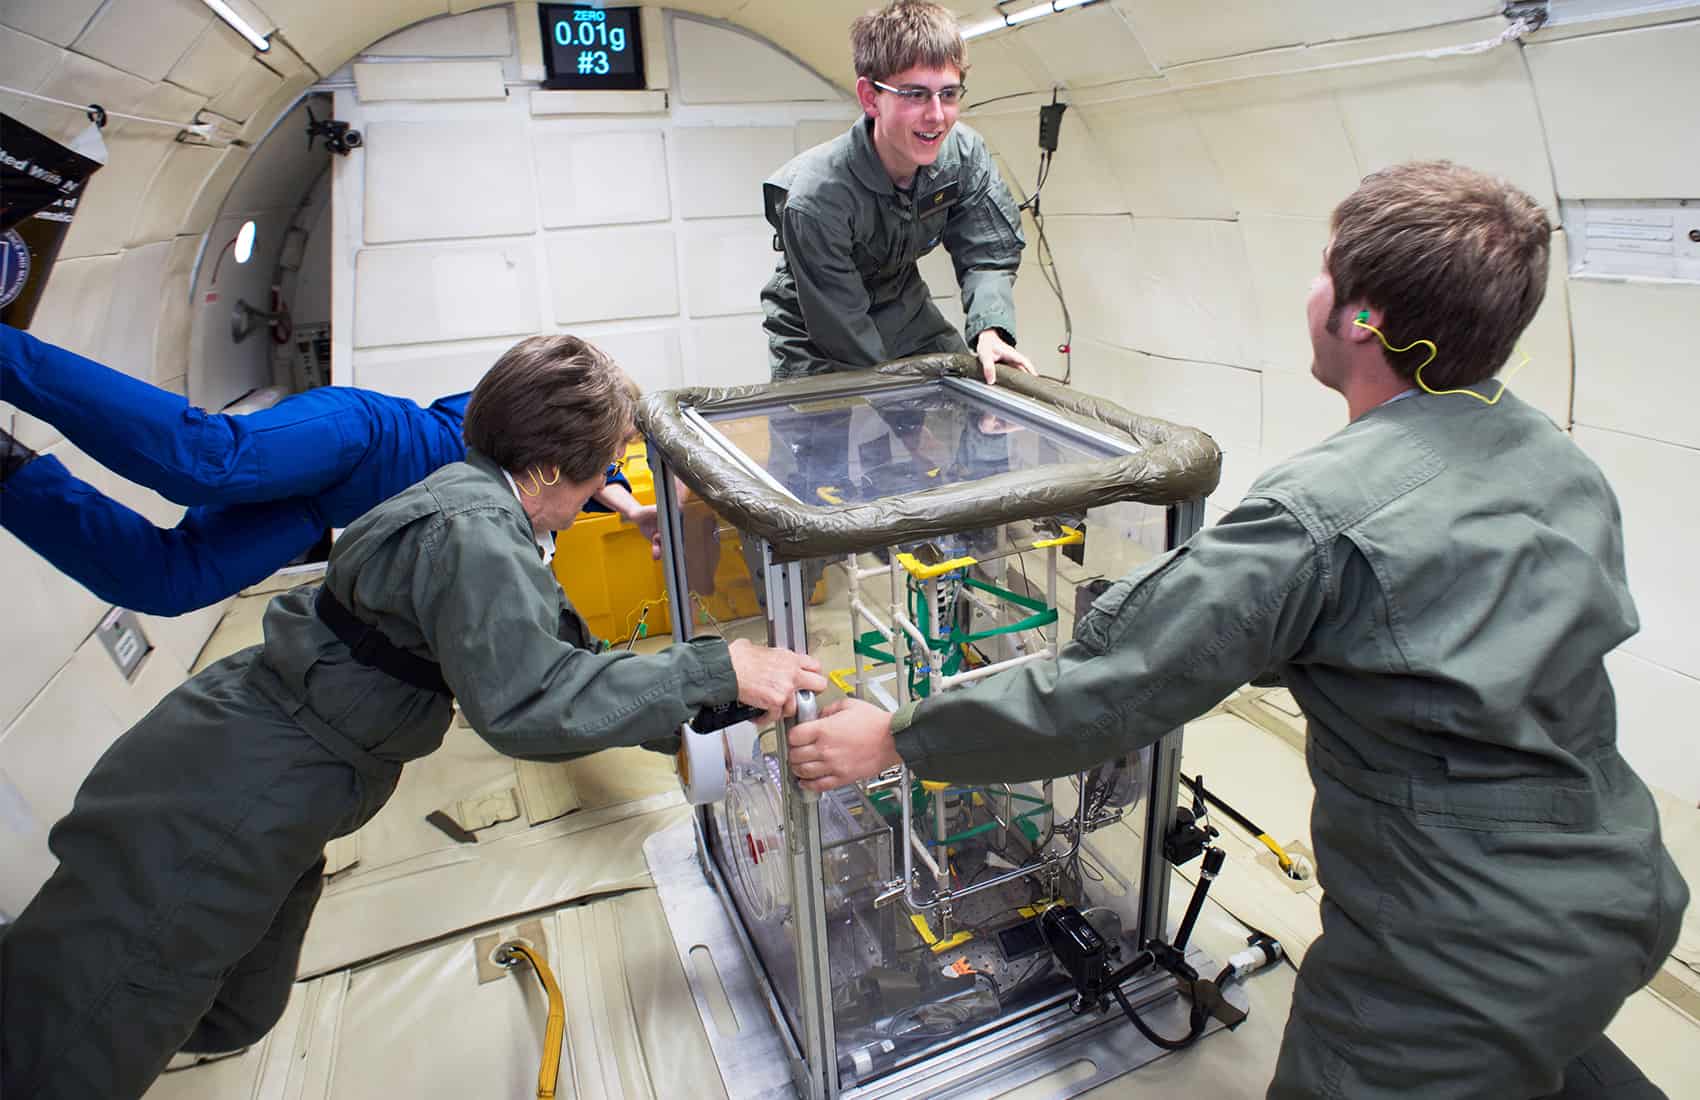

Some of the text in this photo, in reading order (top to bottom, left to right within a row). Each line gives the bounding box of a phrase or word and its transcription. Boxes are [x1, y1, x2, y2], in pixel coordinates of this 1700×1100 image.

[573, 10, 606, 21] ZERO
[555, 21, 625, 51] 0.01g
[577, 50, 609, 74] #3
